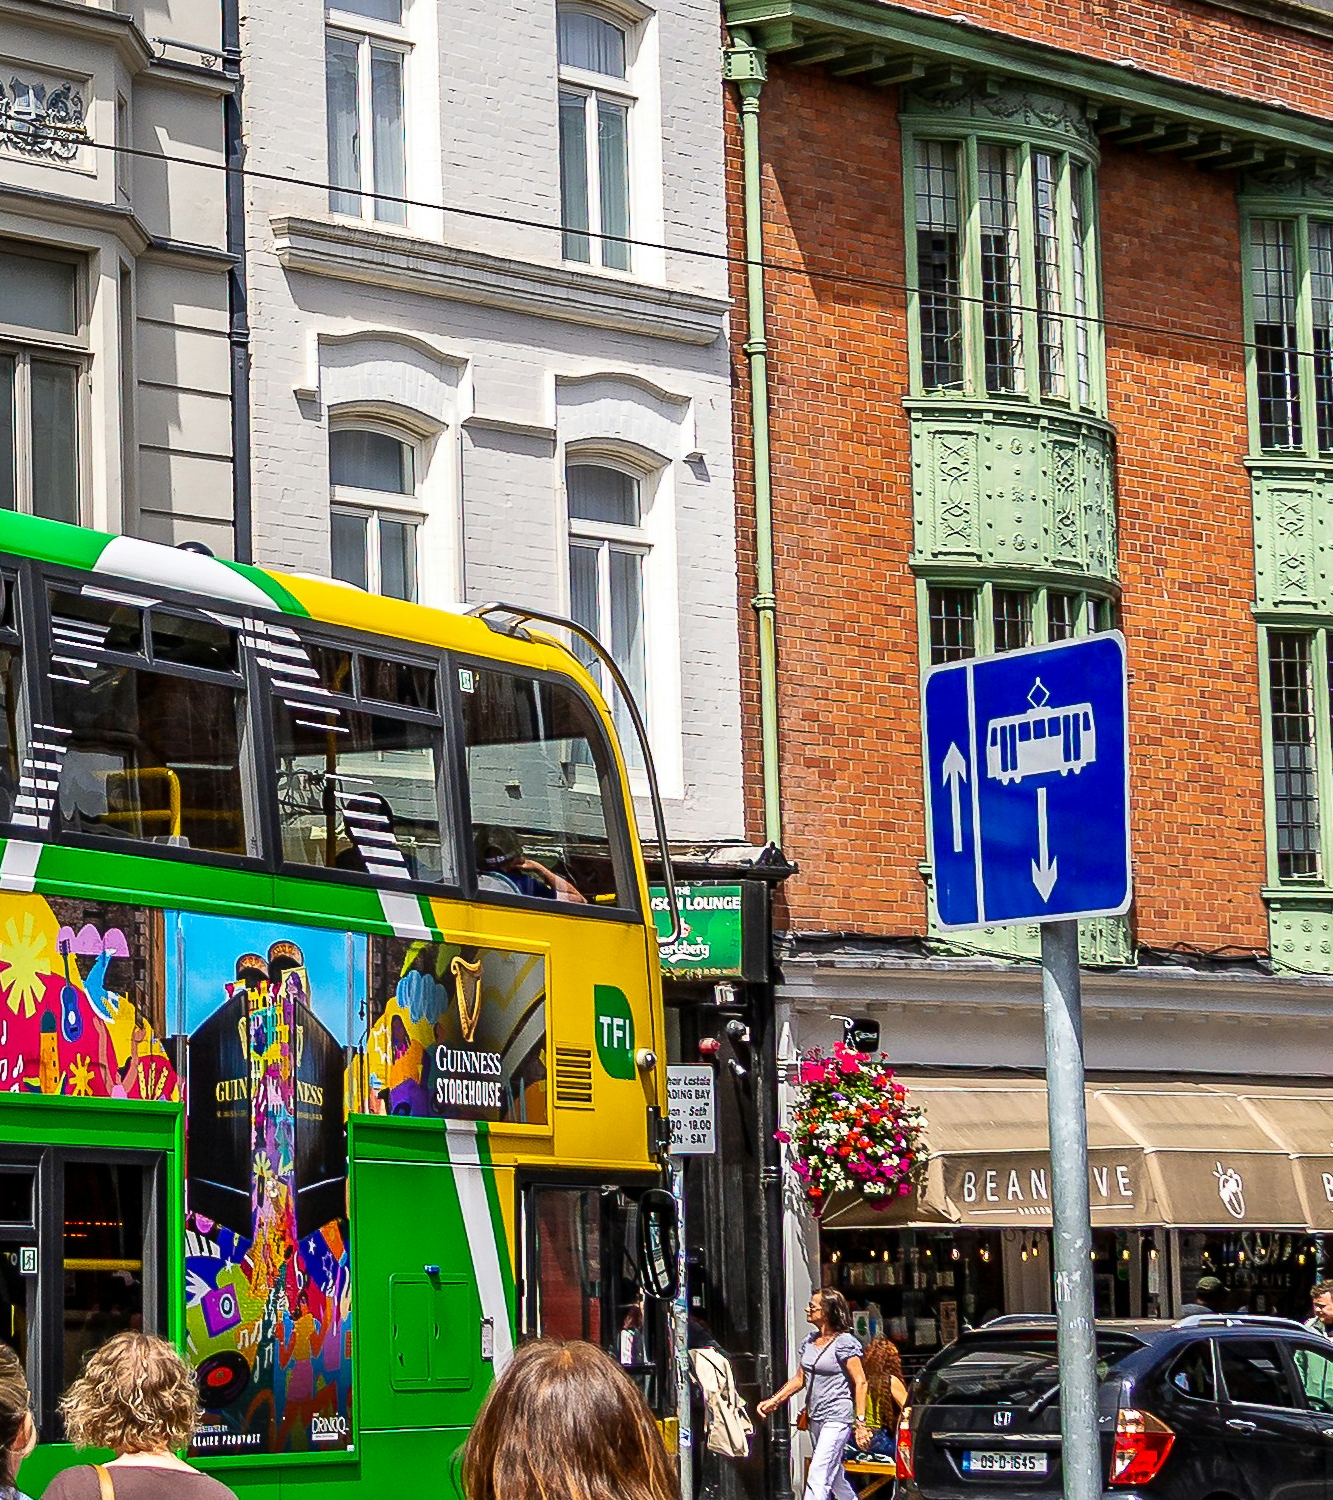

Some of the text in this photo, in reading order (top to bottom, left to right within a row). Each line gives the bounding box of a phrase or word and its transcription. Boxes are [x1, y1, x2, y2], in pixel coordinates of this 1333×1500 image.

[686, 896, 741, 911] LOUNGE
[599, 1015, 631, 1050] TFI
[435, 1044, 502, 1076] GUINNESS
[436, 1077, 502, 1108] STOREHOUSE
[668, 1088, 711, 1100] ADING BAY
[671, 1133, 683, 1144] ON
[690, 1133, 707, 1144] SAT
[962, 1164, 1133, 1203] BEANVE
[980, 1454, 1037, 1471] 09-D-1645
